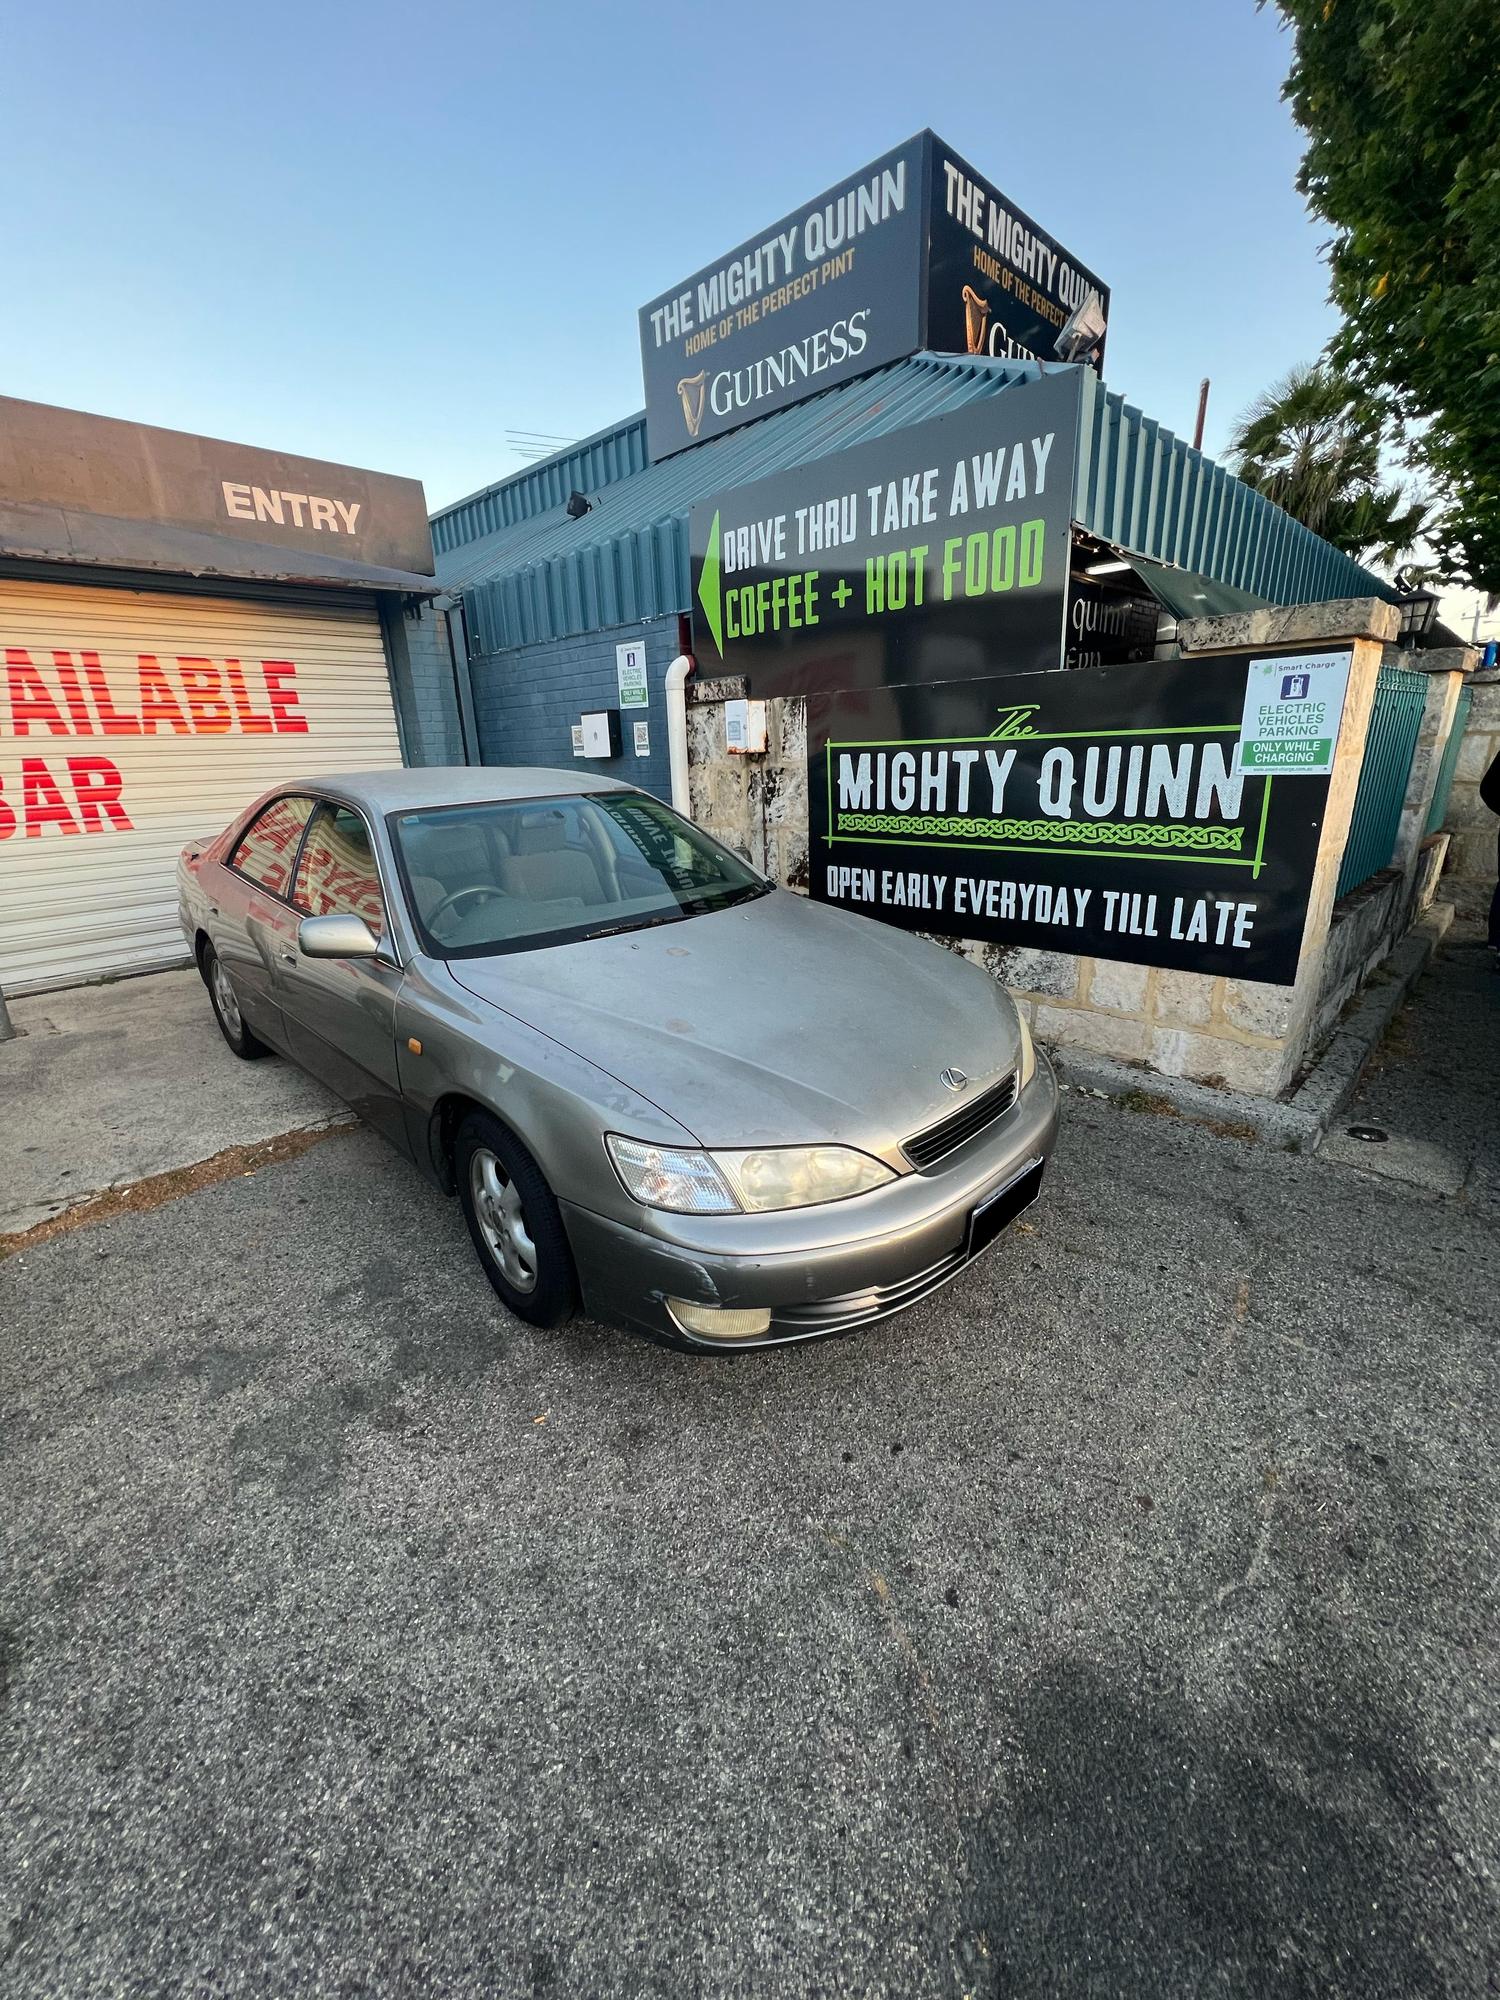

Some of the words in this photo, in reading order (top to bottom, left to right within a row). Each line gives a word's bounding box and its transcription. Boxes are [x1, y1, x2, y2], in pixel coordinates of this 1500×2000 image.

[650, 290, 694, 348] THE
[698, 226, 798, 323] MIGHTY
[804, 160, 905, 262] QUINN
[943, 159, 985, 239] THE
[988, 199, 1057, 293] MIGHTY
[685, 325, 718, 358] HOME
[719, 319, 734, 341] OF
[735, 301, 760, 331] THE
[762, 268, 818, 318] PERFECT
[821, 247, 855, 286] PINT
[973, 245, 1000, 284] HOME
[1001, 267, 1013, 291] OF
[1014, 278, 1031, 306] THE
[1031, 289, 1064, 329] PERFECT
[710, 309, 869, 416] GUINNESS
[220, 480, 361, 535] ENTRY
[723, 514, 786, 574] DRIVE
[794, 493, 857, 555] THRU
[867, 468, 939, 537] TAKE
[949, 432, 1055, 517] AWAY
[725, 570, 819, 639] COFFEE
[866, 545, 929, 615] HOT
[942, 518, 1045, 601] FOOD
[1278, 663, 1303, 672] Smart
[1305, 661, 1336, 670] Charge
[989, 704, 1041, 738] The
[1252, 742, 1283, 752] ONLY
[1284, 741, 1321, 752] WHILE
[1258, 713, 1325, 726] VEHICLES
[1259, 702, 1327, 715] ELECTRIC
[1259, 725, 1319, 737] PARKING
[837, 748, 1017, 814] MIGHTY
[1036, 743, 1244, 820] QUINN
[1254, 752, 1315, 763] CHARGING
[826, 865, 875, 903] OPEN
[881, 870, 948, 910] EARLY
[954, 877, 1092, 928] EVERYDAY
[1102, 890, 1158, 937] TILL
[1170, 897, 1258, 949] LATE
